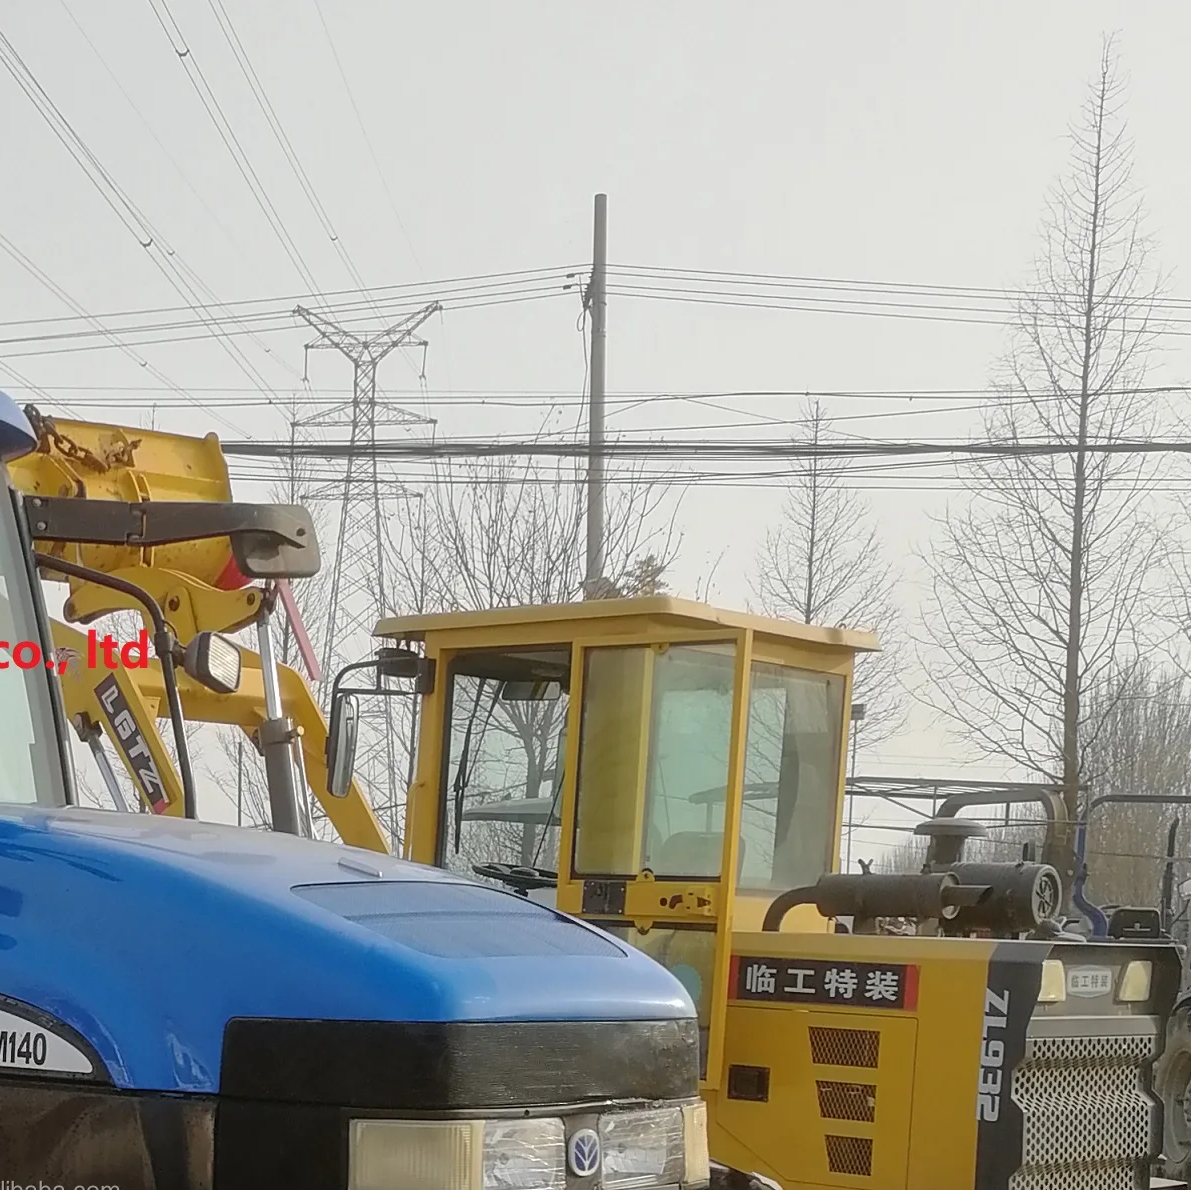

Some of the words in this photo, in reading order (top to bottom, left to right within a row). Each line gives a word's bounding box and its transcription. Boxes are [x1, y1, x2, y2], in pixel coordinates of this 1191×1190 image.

[745, 963, 899, 1002] 临工特装
[976, 987, 1010, 1123] ZL932
